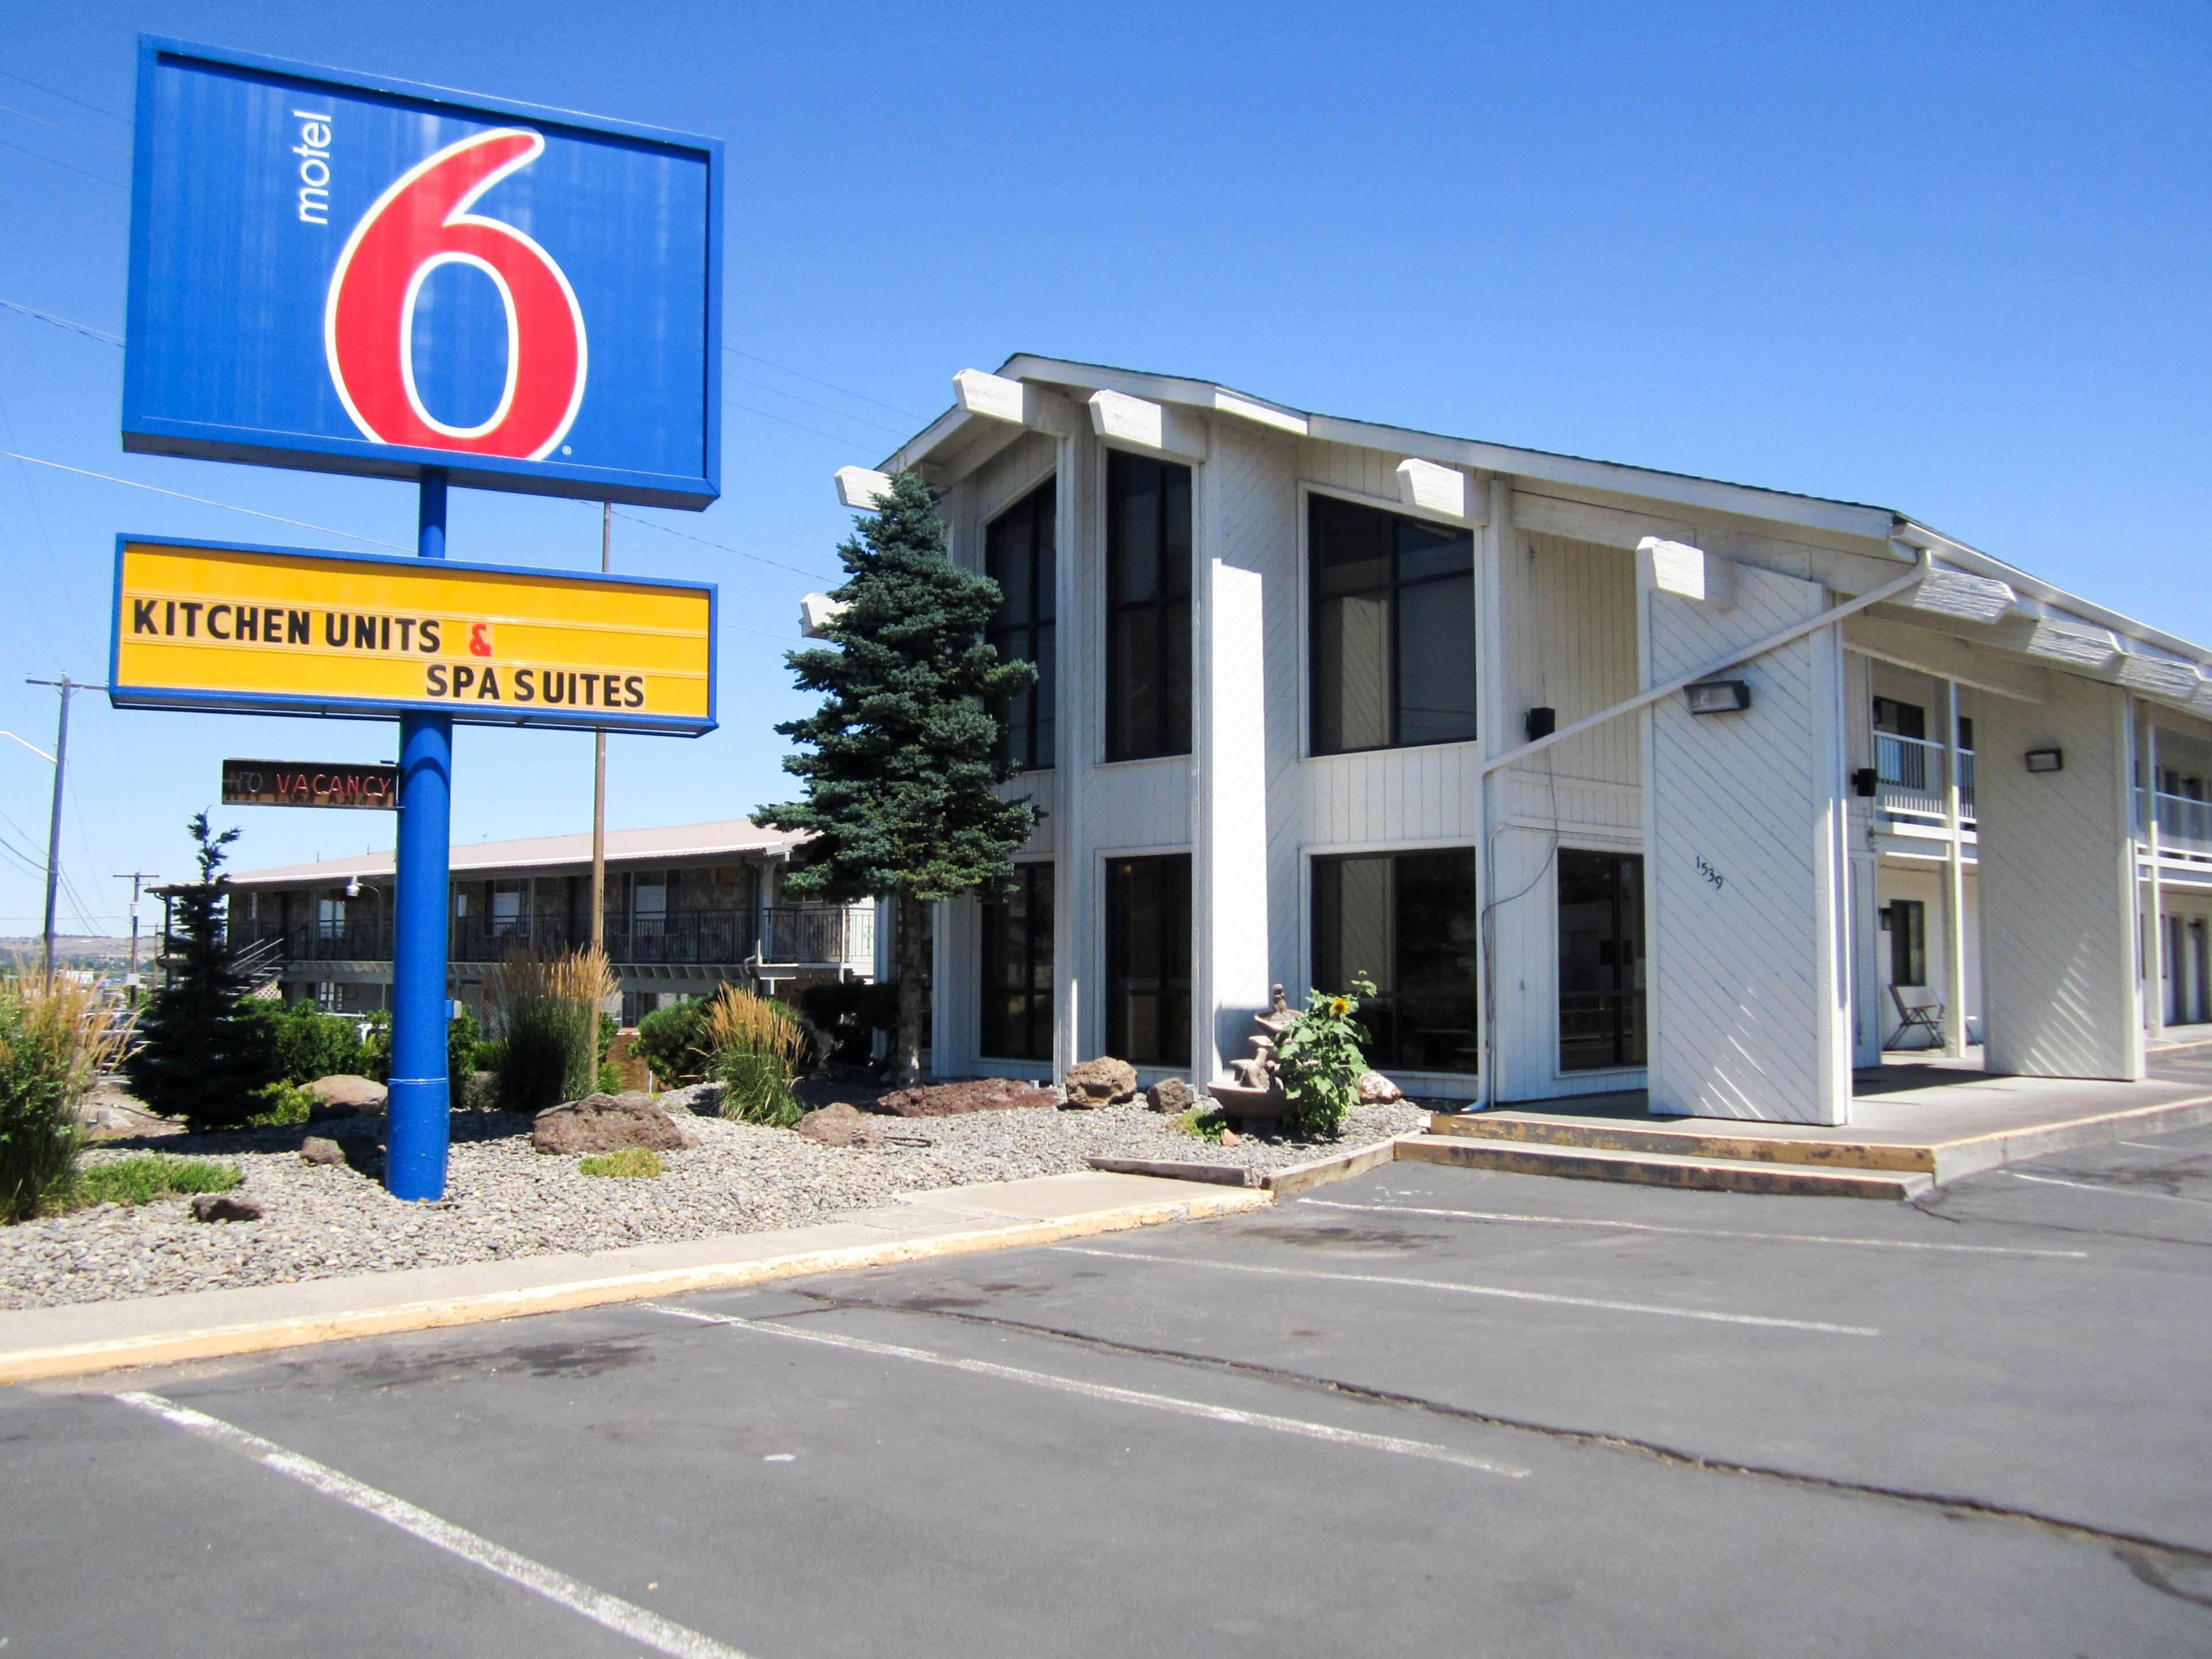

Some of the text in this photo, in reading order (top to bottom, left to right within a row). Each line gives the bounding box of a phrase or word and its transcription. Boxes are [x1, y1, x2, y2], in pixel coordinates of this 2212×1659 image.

[293, 110, 332, 225] motel
[324, 125, 588, 461] 6
[133, 599, 492, 656] KITCHEN UNITS &
[426, 664, 644, 707] SPA SUITES
[276, 774, 392, 797] VACANCY
[1696, 855, 1724, 890] 1539
